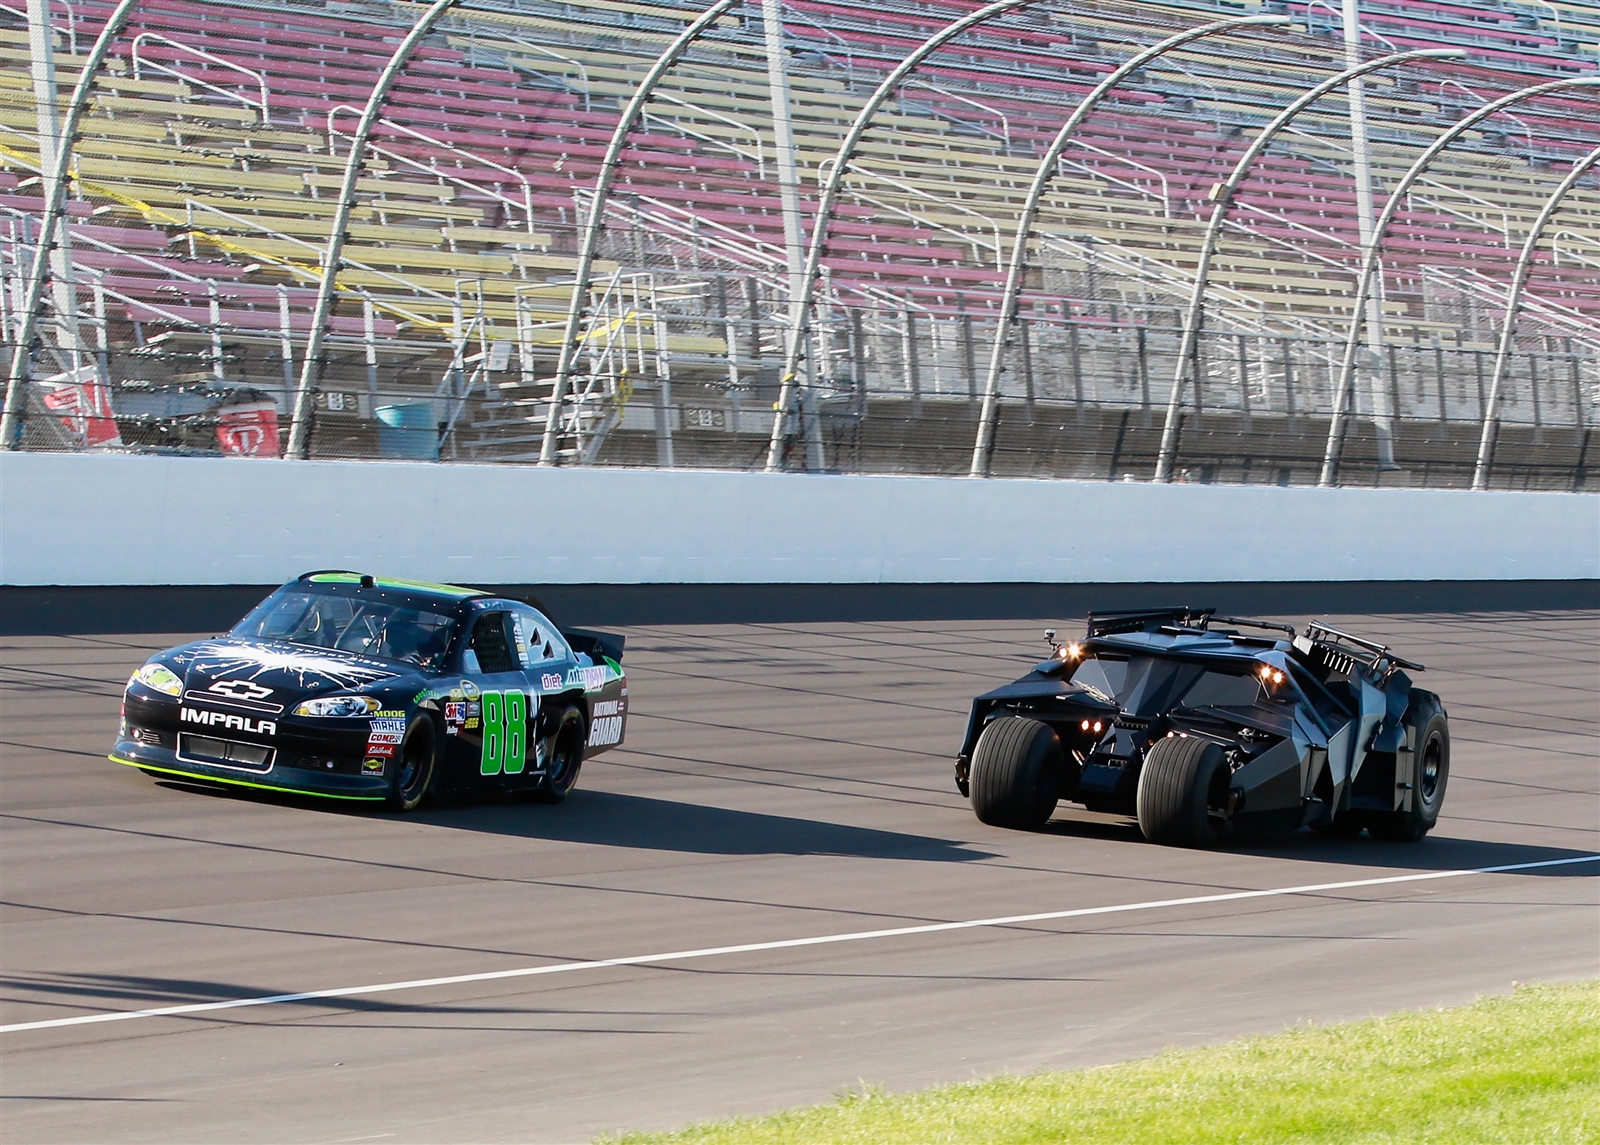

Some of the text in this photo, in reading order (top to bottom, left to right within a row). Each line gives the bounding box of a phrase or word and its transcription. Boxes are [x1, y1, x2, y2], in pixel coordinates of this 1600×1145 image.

[542, 674, 562, 689] diet
[413, 688, 440, 704] GOODYEAR
[373, 710, 406, 718] MOOG
[593, 700, 618, 718] NATIONAL
[180, 707, 276, 736] IMPALA
[371, 721, 405, 731] MAHLE
[480, 688, 526, 776] 88
[588, 716, 622, 747] GUARD
